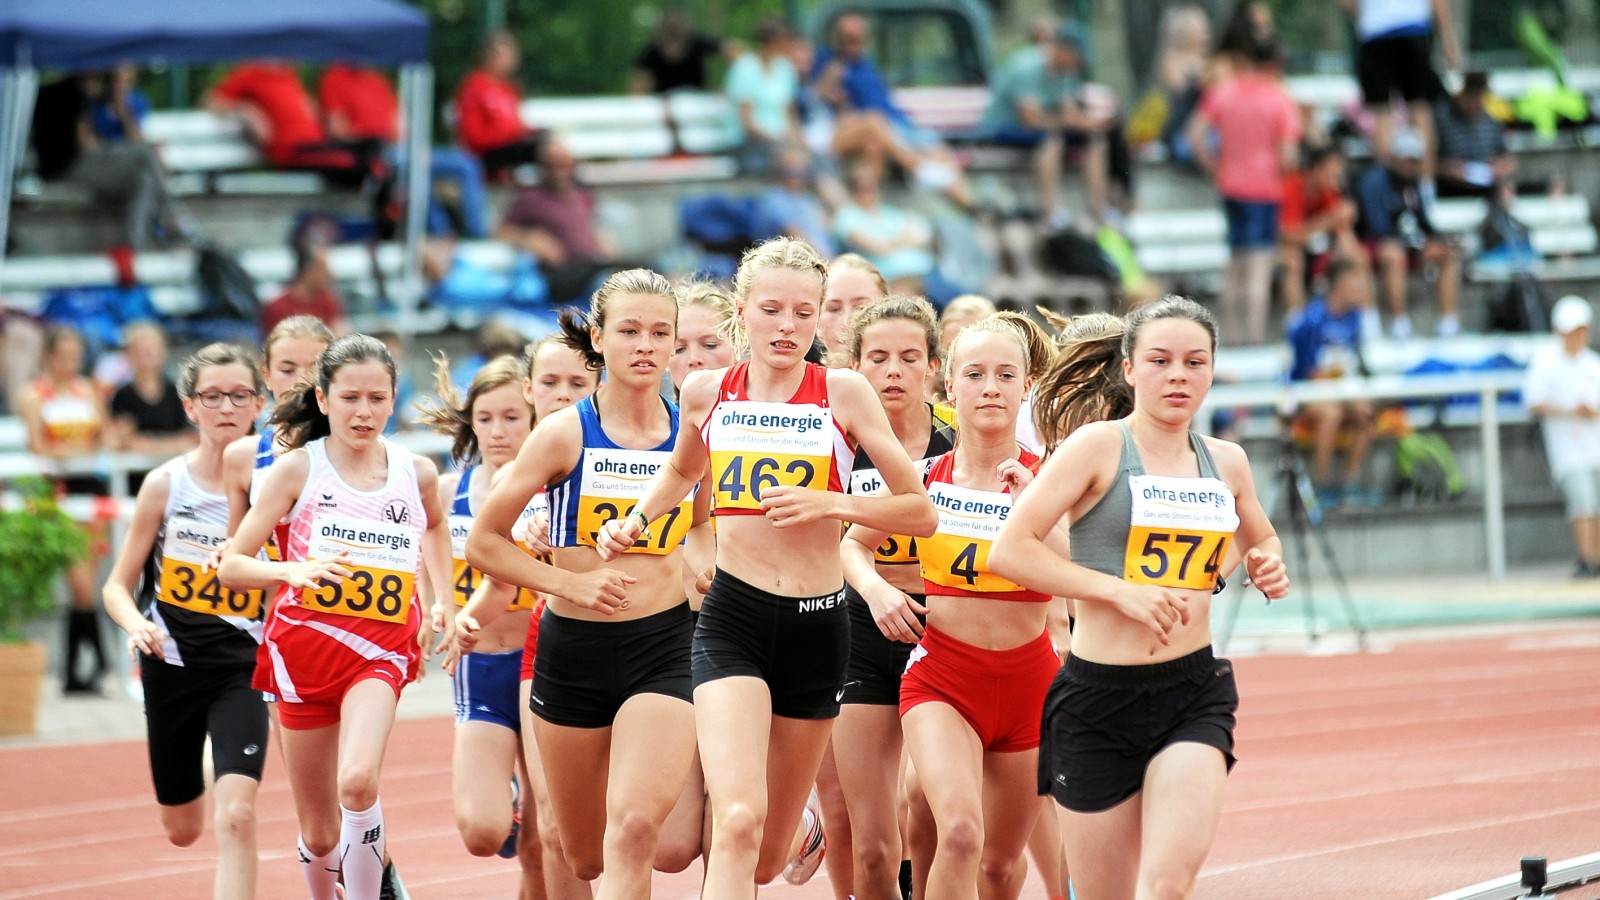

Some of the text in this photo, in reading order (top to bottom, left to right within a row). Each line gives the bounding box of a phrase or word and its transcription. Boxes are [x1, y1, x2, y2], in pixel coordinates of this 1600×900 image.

[721, 410, 823, 433] ohra energie
[594, 458, 627, 474] ohra
[592, 481, 605, 490] Gas
[620, 483, 639, 491] Strom
[718, 455, 815, 503] 462
[862, 477, 881, 493] oh
[1143, 485, 1177, 502] ohra
[964, 501, 1011, 521] energ
[949, 519, 970, 529] Strom
[971, 521, 981, 530] für
[983, 524, 994, 532] die
[321, 524, 411, 550] ohra energie
[1140, 532, 1227, 582] 574
[315, 571, 403, 617] 538
[799, 596, 835, 613] NIKE
